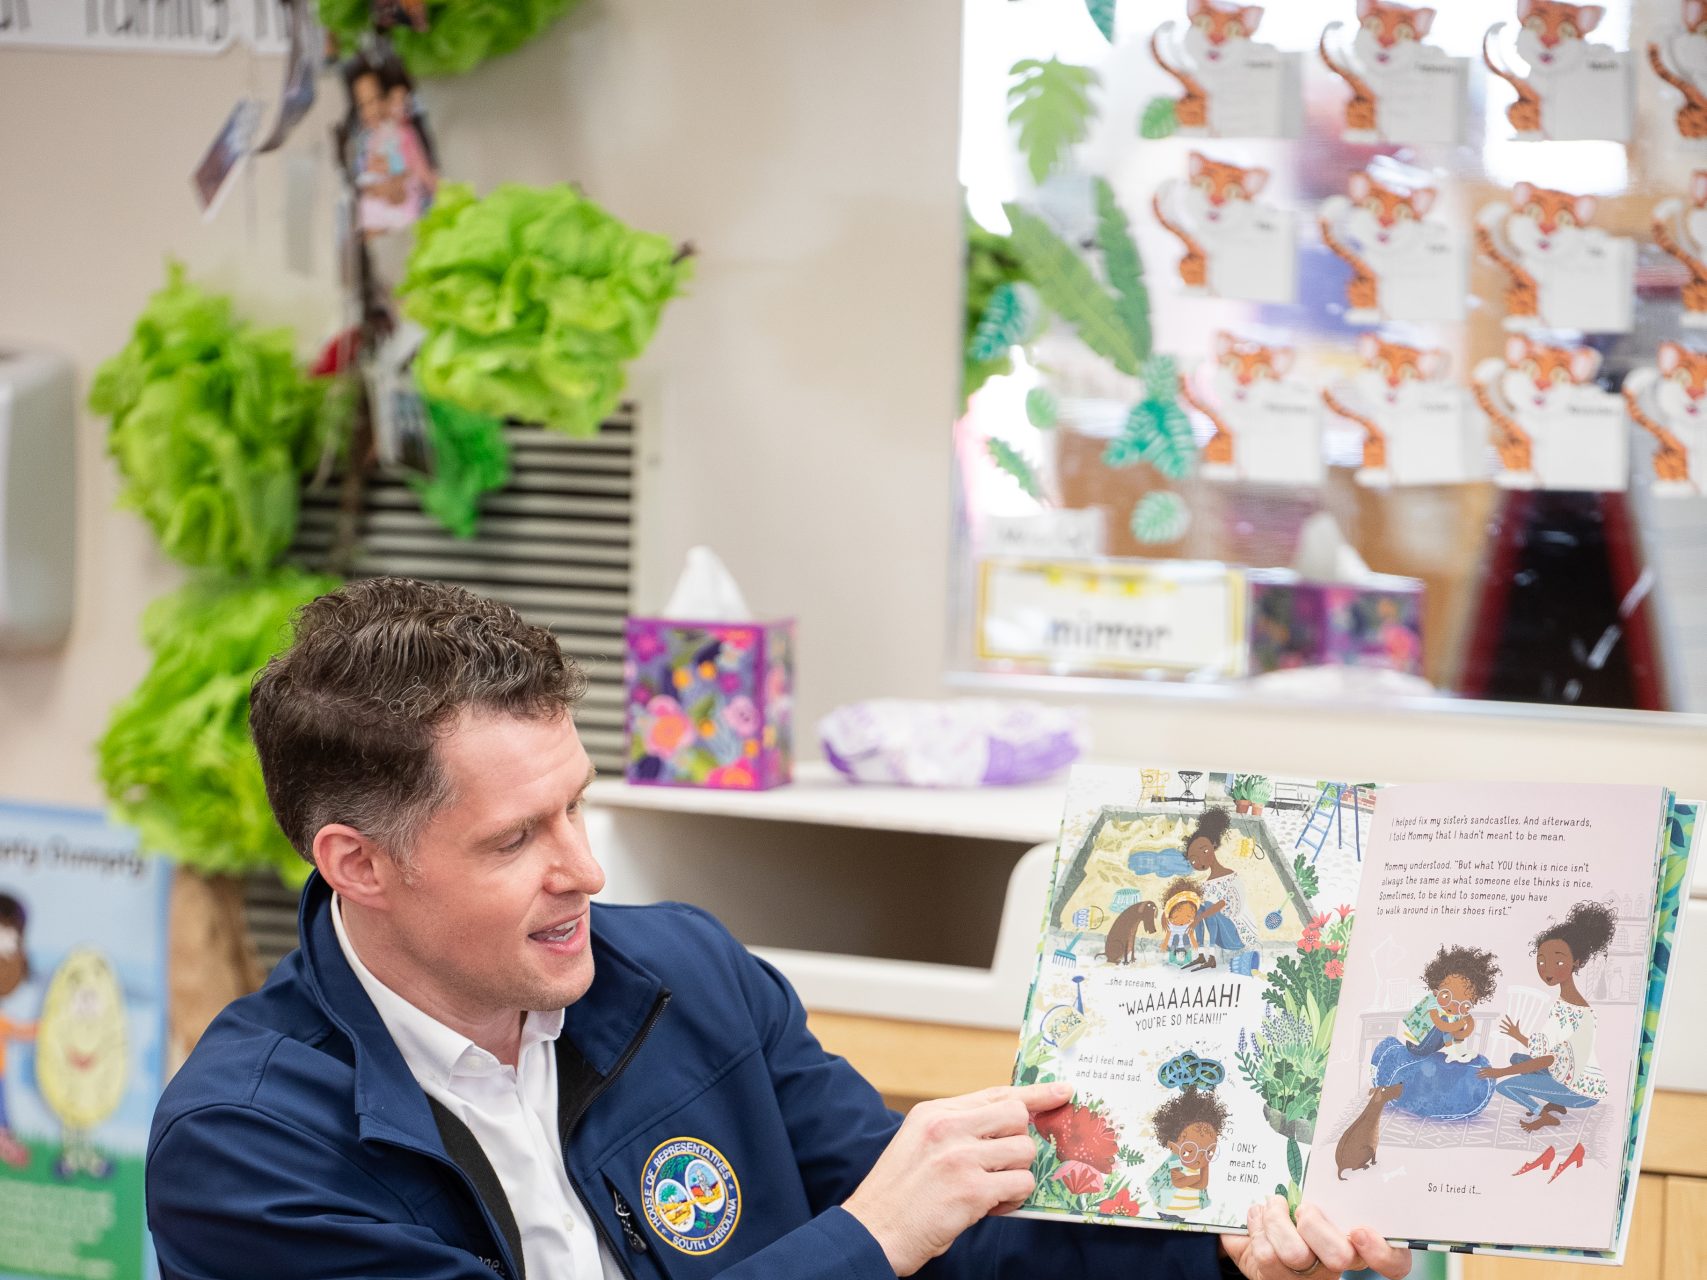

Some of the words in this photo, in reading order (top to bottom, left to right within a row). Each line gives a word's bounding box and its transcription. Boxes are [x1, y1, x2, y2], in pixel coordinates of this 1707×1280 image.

[1047, 610, 1172, 651] mirror
[1396, 816, 1416, 828] helped
[1418, 816, 1428, 826] fix
[1430, 818, 1440, 828] my
[1443, 815, 1468, 825] sister's
[1470, 816, 1520, 825] sandcastles.
[1524, 816, 1540, 826] And
[1542, 816, 1592, 828] afterwards,
[1393, 832, 1406, 841] told
[1408, 832, 1433, 842] Mommy
[1436, 830, 1452, 840] that
[1459, 830, 1484, 840] hadn't
[1486, 831, 1512, 840] meant
[1516, 832, 1524, 840] to
[1528, 830, 1538, 840] be
[1540, 833, 1566, 842] mean.
[1384, 862, 1408, 872] Mommy
[1474, 860, 1494, 870] what
[1498, 860, 1513, 870] YOU
[1516, 862, 1537, 871] think
[1540, 863, 1548, 872] is
[1550, 864, 1568, 872] nice
[1570, 863, 1589, 872] isn't
[1382, 877, 1404, 888] always
[1406, 876, 1418, 884] the
[1453, 875, 1472, 884] what
[1474, 878, 1510, 886] someone
[1514, 876, 1530, 886] else
[1534, 877, 1560, 887] thinks
[1562, 878, 1570, 888] is
[1573, 880, 1593, 888] nice.
[1418, 890, 1426, 900] to
[1428, 890, 1438, 900] be
[1440, 890, 1456, 900] kind
[1460, 890, 1468, 900] to
[1470, 892, 1508, 902] someone,
[1510, 894, 1526, 903] you
[1528, 892, 1548, 902] have
[1376, 906, 1384, 916] to
[1386, 906, 1400, 915] walk
[1402, 906, 1428, 914] around
[1430, 906, 1438, 914] in
[1441, 905, 1460, 914] their
[1462, 905, 1486, 914] shoes
[1136, 1014, 1167, 1032] YOU'RE
[1170, 1014, 1182, 1026] SO
[1078, 1054, 1093, 1064] And
[1100, 1055, 1115, 1065] feel
[1117, 1058, 1134, 1066] mad
[1076, 1070, 1090, 1078] and
[1092, 1070, 1108, 1078] bad
[1110, 1072, 1125, 1080] and
[1236, 1142, 1258, 1154] ONLY
[653, 1142, 732, 1180] REPRESENTATIVES
[1230, 1160, 1255, 1168] meant
[1258, 1160, 1267, 1170] to
[646, 1168, 655, 1186] OF
[1227, 1172, 1236, 1182] be
[1240, 1173, 1260, 1184] KIND.
[1428, 1182, 1438, 1192] So
[1446, 1184, 1466, 1194] tried
[644, 1189, 662, 1228] HOUSE
[672, 1235, 706, 1250] SOUTH
[708, 1198, 737, 1246] CAROLINA
